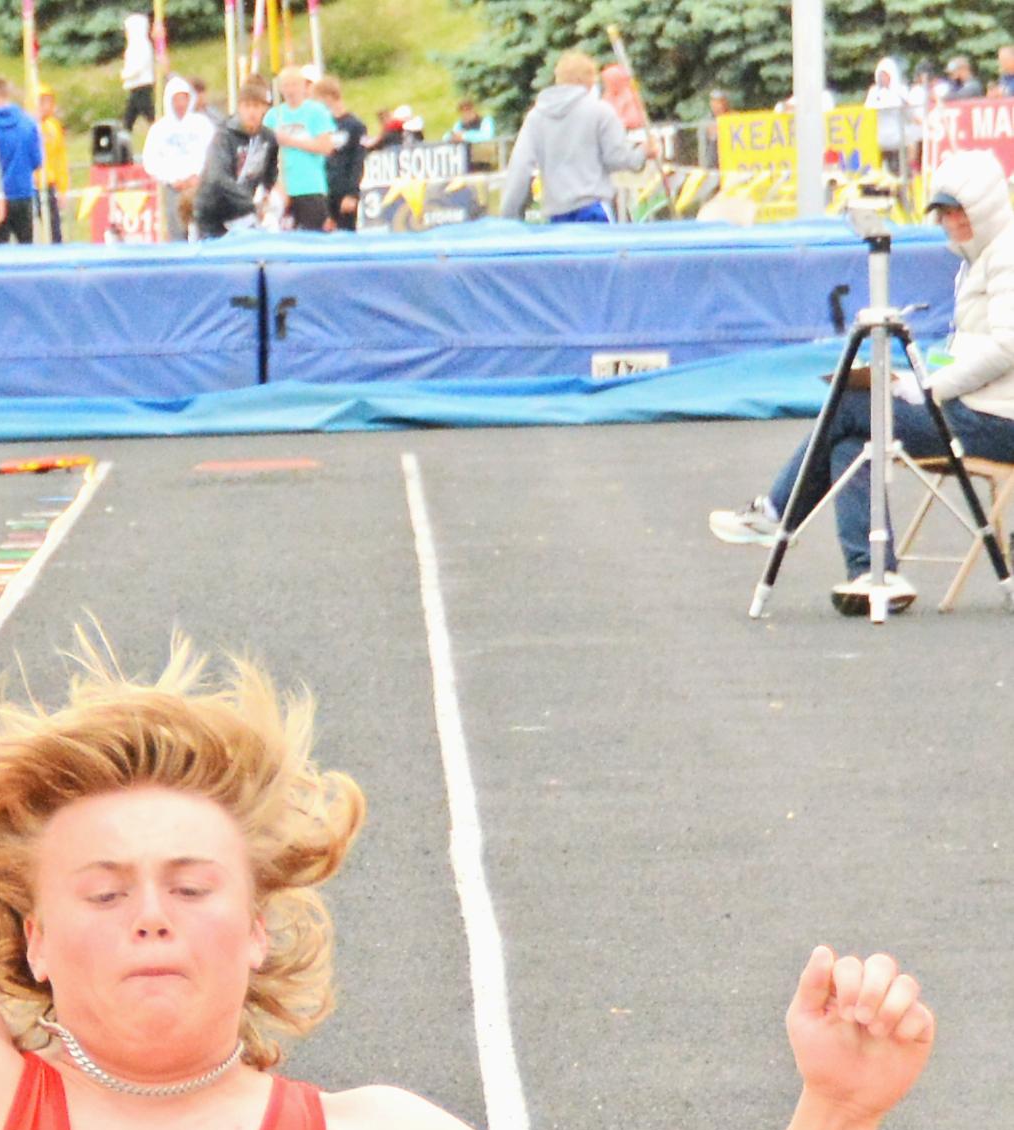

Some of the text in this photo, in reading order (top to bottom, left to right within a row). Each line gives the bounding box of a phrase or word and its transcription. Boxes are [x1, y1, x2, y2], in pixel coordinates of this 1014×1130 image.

[729, 114, 863, 150] KEAEY
[972, 105, 1013, 139] MA
[399, 144, 463, 178] SOUTH
